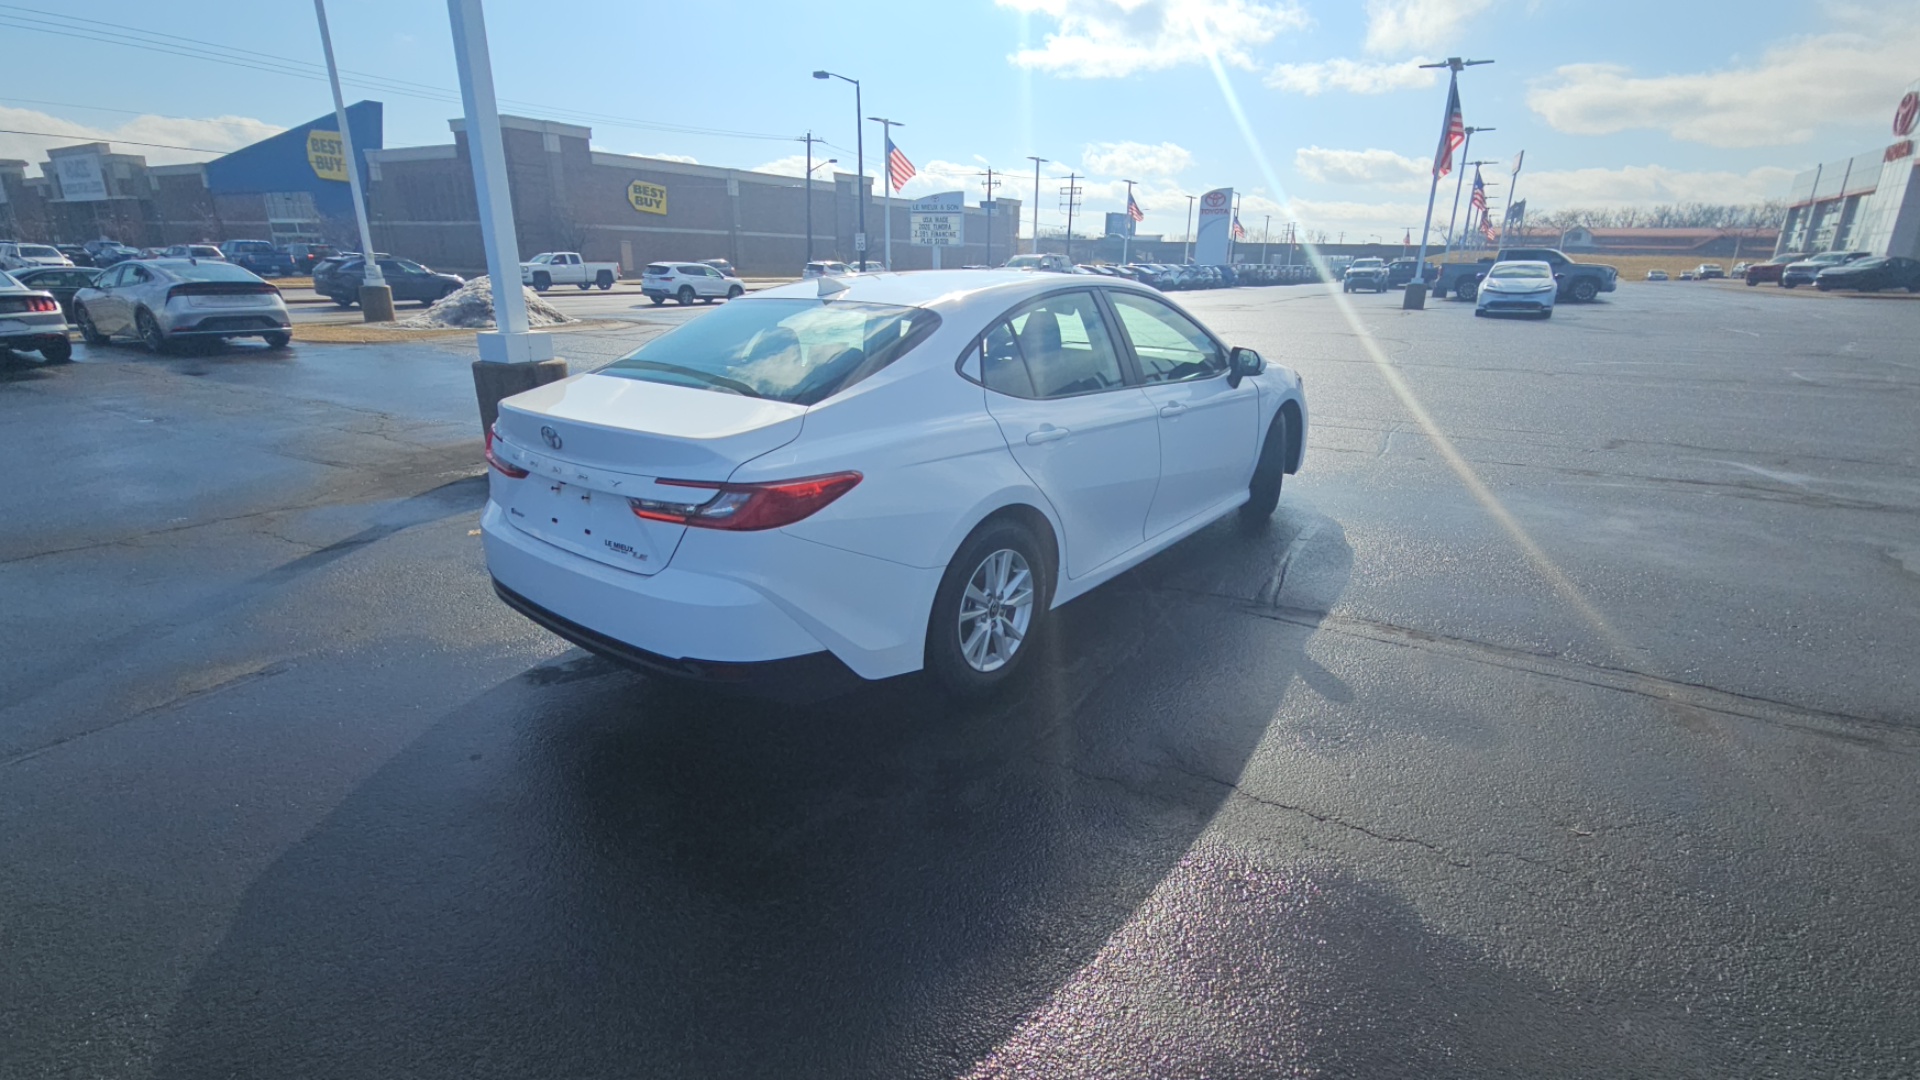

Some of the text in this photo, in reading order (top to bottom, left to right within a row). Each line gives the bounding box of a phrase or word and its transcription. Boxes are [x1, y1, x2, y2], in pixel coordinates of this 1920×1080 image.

[311, 137, 342, 155] BEST
[315, 154, 342, 172] BUY
[633, 184, 664, 199] BEST
[635, 195, 662, 209] BUY
[604, 539, 612, 547] LE
[613, 541, 633, 552] MIEUX
